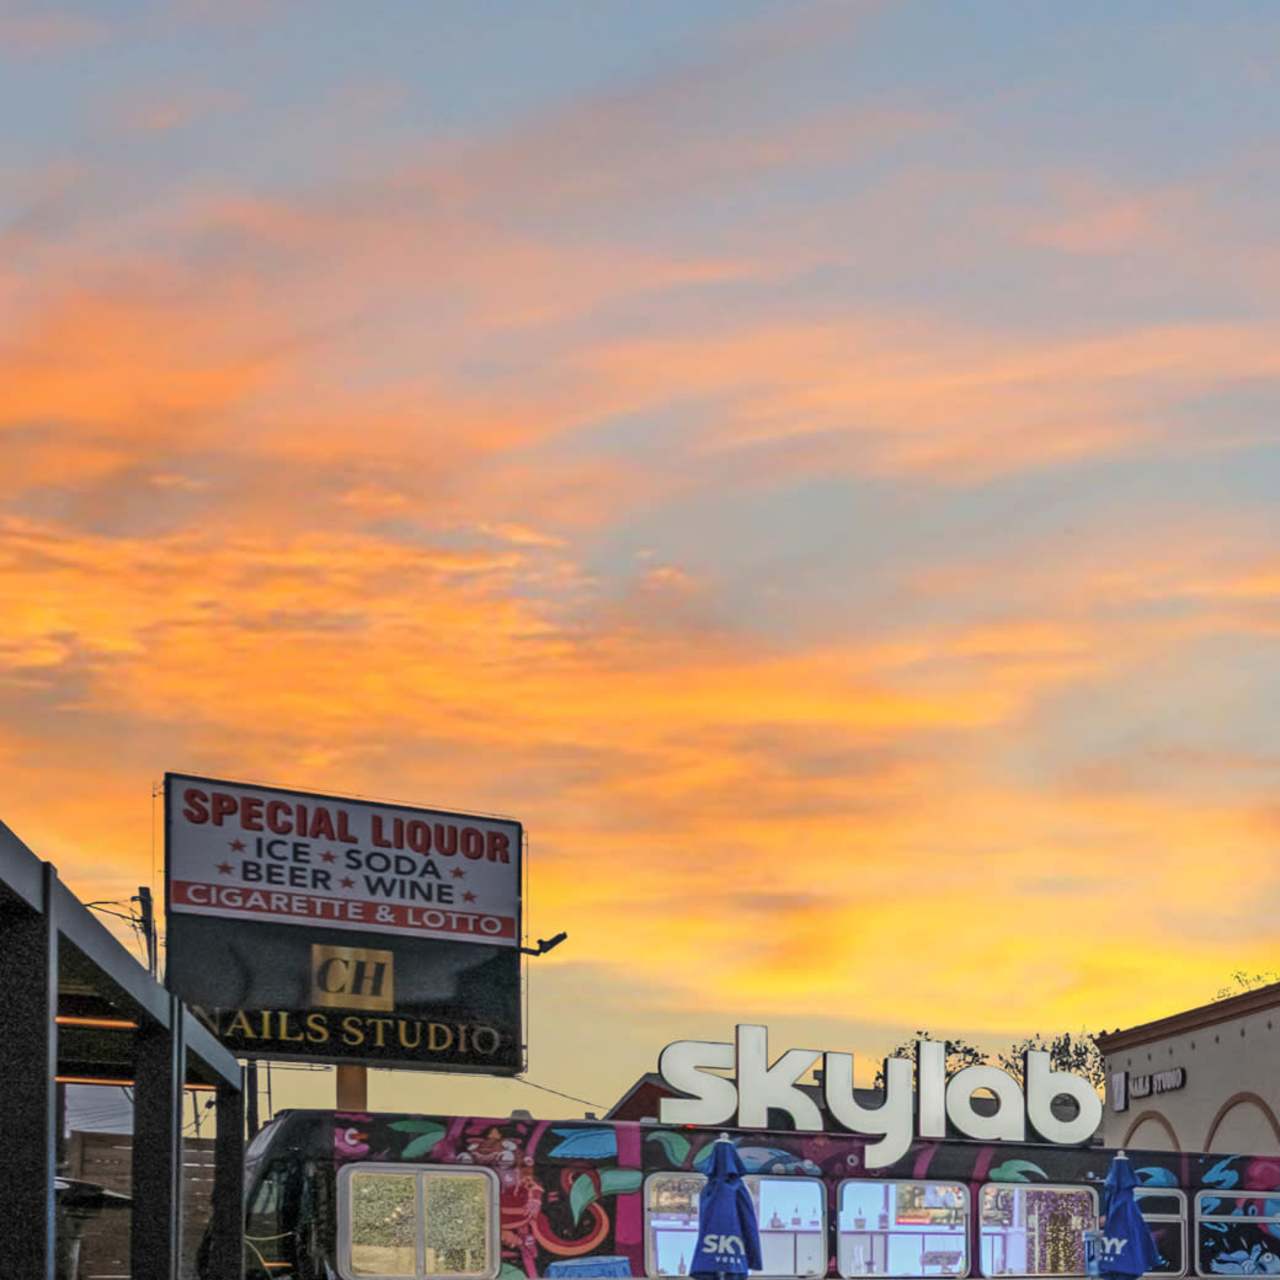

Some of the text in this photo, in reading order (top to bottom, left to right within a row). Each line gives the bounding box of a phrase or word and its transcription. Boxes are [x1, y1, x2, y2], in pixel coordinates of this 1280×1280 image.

[183, 787, 511, 864] SPECIAL LIQUOR
[241, 860, 455, 904] BEER WINE
[255, 837, 442, 880] ICE SODA
[186, 883, 503, 935] CIGARETTE & LOTTO
[316, 956, 387, 998] CH
[190, 1004, 501, 1056] NAILS STUDIO
[659, 1023, 1103, 1169] skylab
